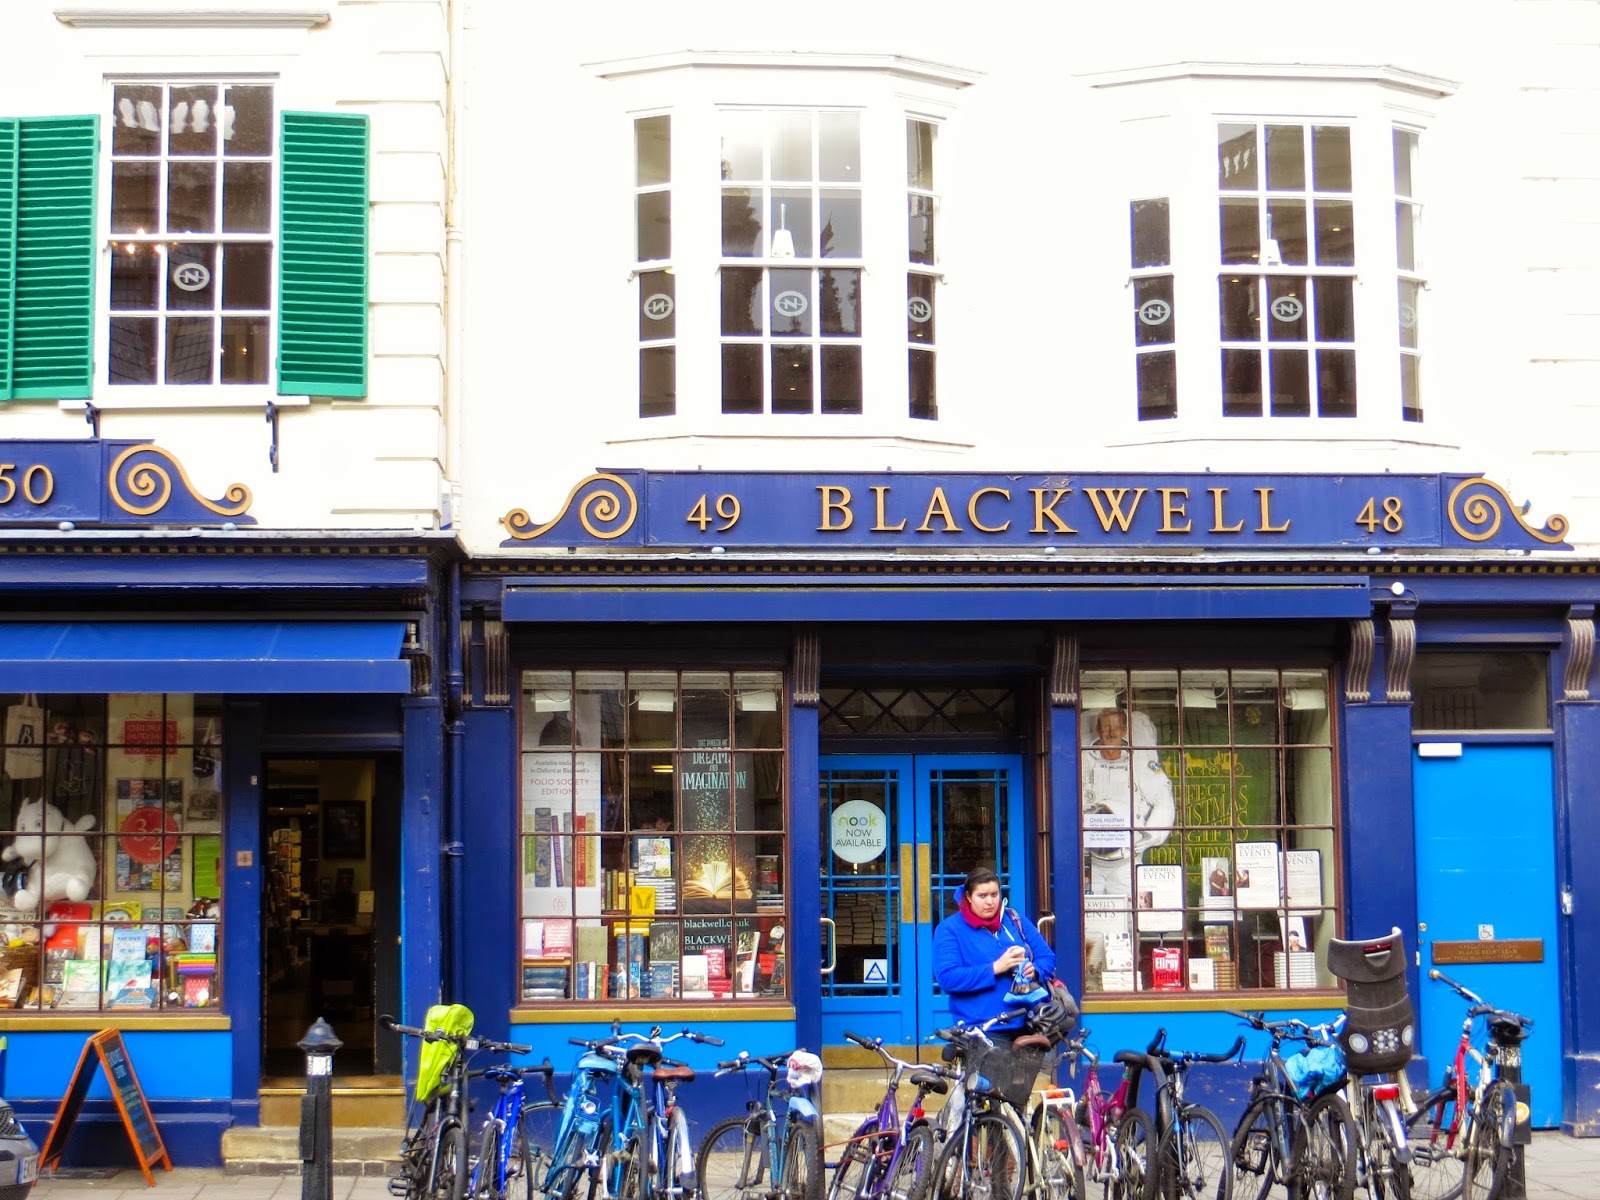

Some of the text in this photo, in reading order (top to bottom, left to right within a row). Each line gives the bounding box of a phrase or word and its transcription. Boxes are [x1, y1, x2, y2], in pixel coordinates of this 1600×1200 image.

[0, 464, 54, 504] 50
[686, 485, 1404, 534] 49 BLACKWELL 48
[692, 747, 731, 764] DREAM
[681, 771, 746, 790] IMAGINATON
[838, 813, 878, 827] nook
[133, 818, 148, 841] 3
[846, 829, 872, 837] NOW
[150, 827, 163, 851] 2
[835, 838, 882, 847] AVAILABLE
[684, 918, 750, 928] blackwell.c.uk
[1155, 957, 1179, 970] Ellroy
